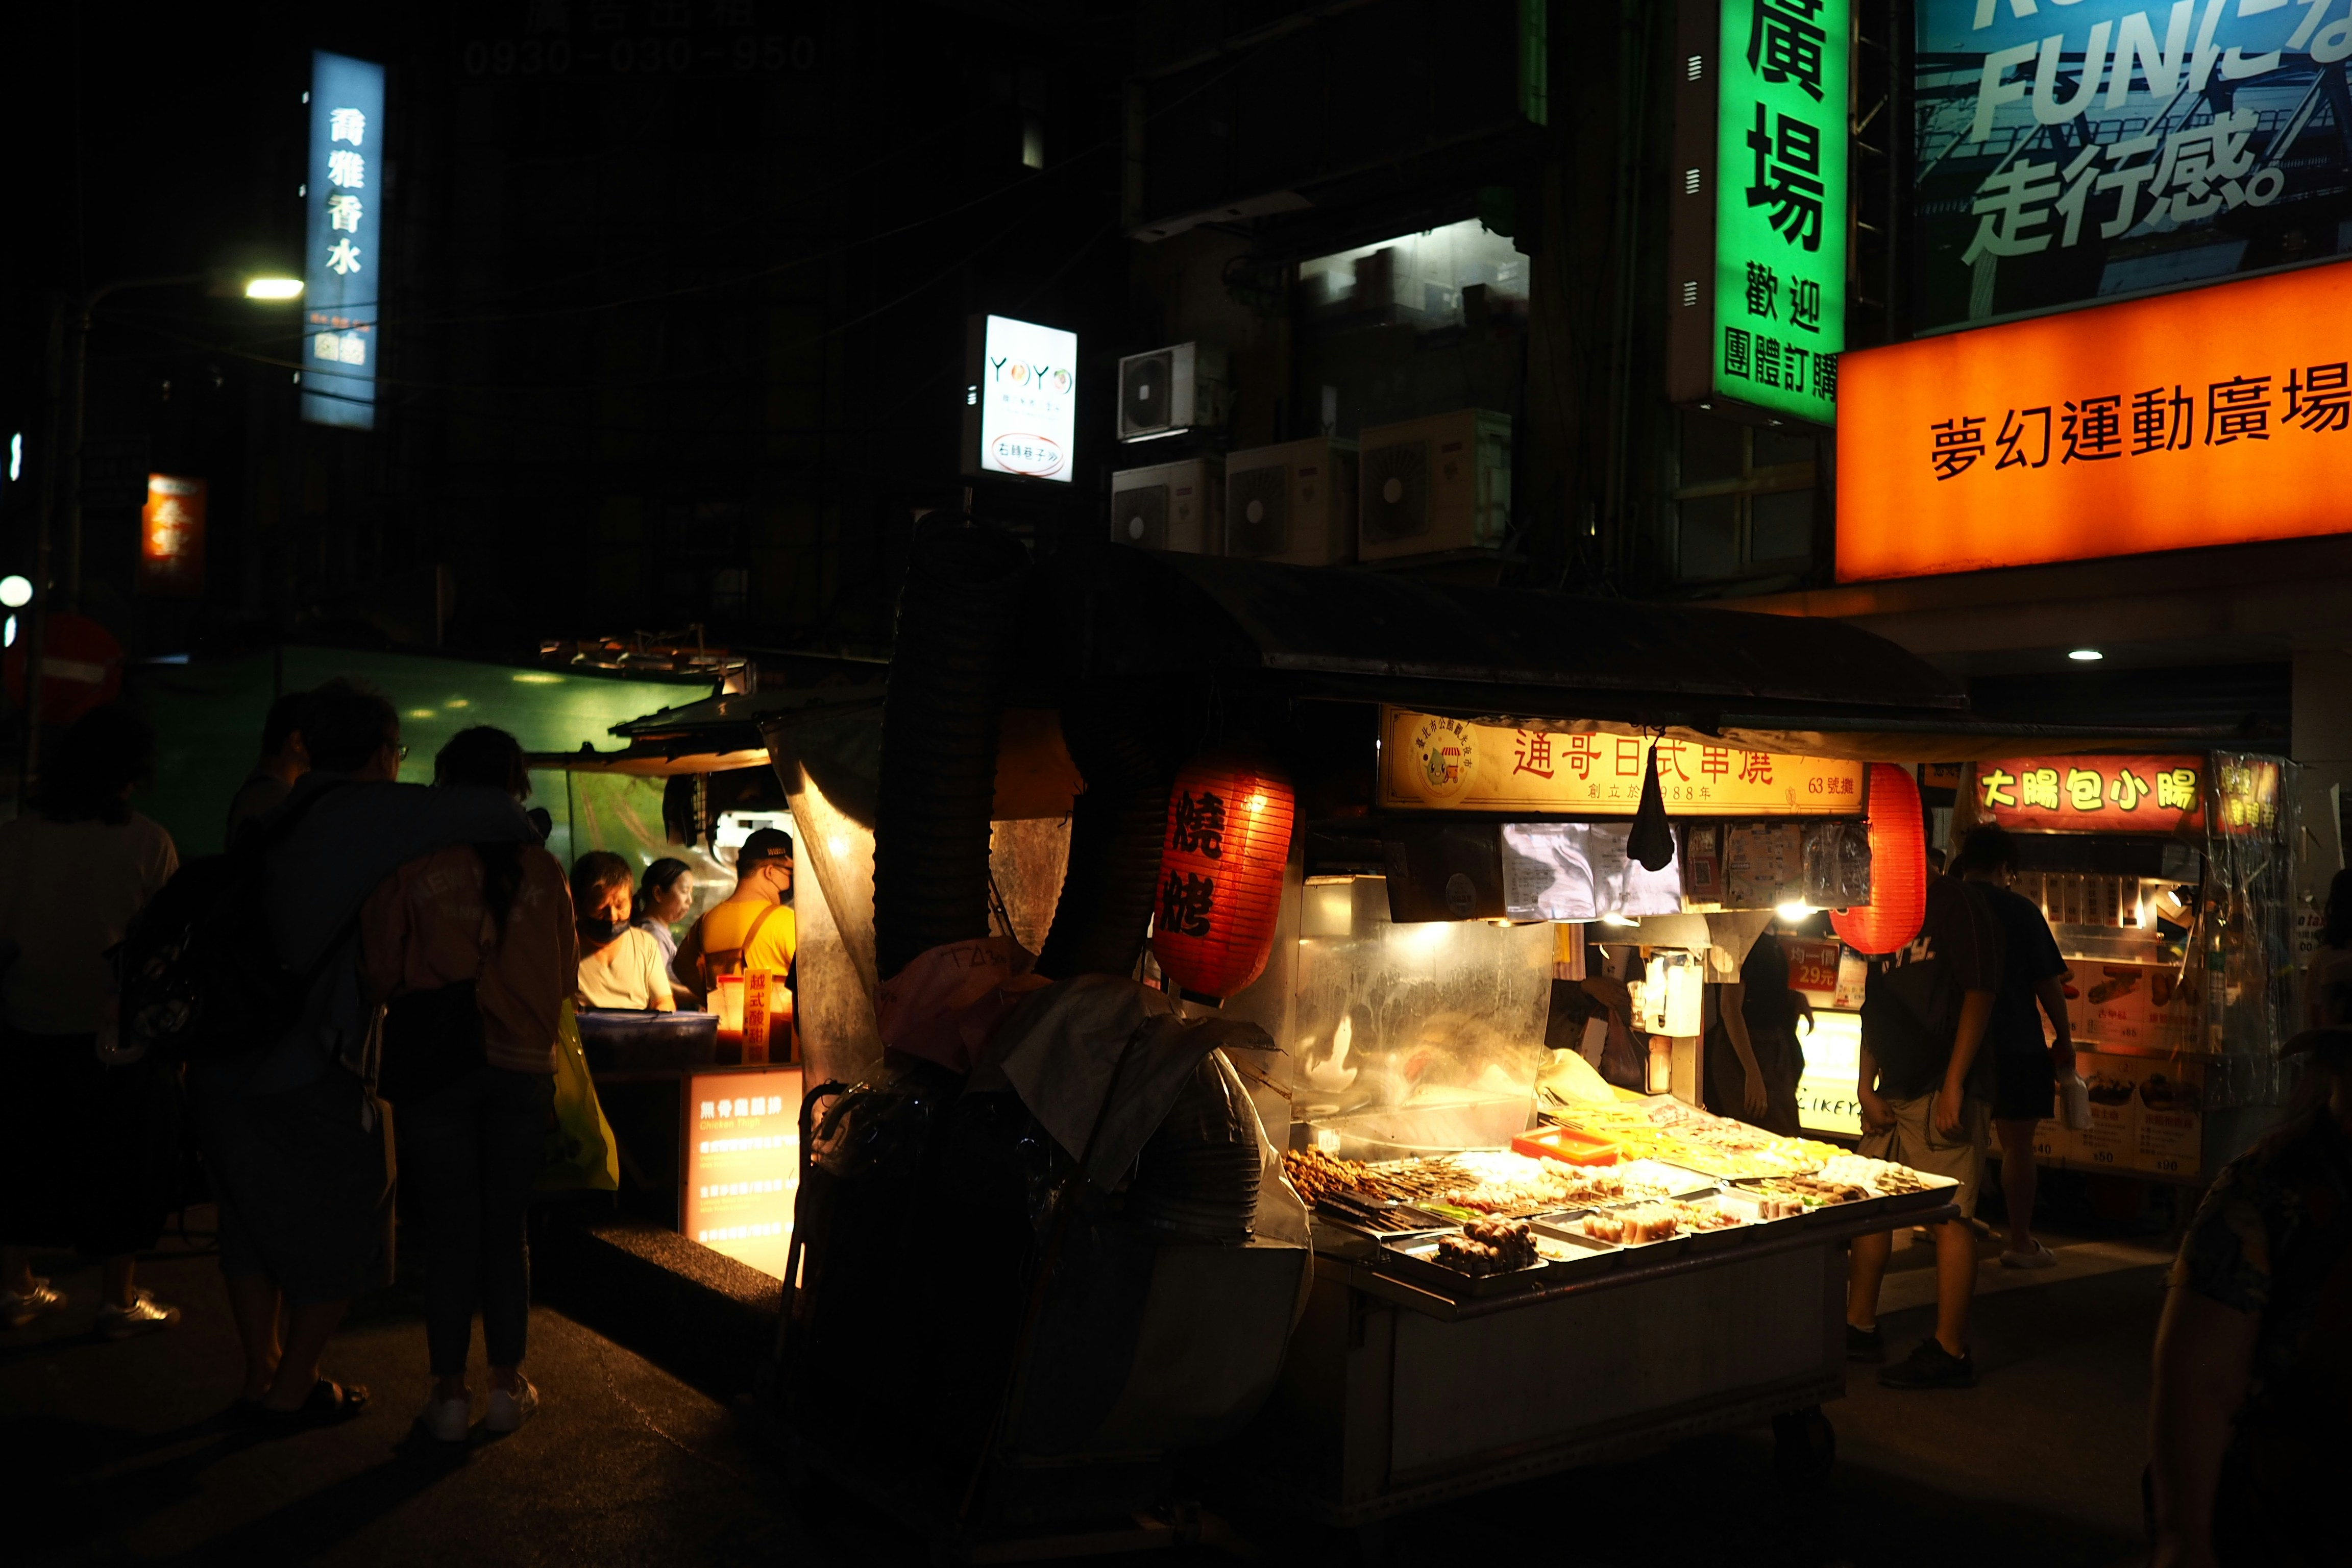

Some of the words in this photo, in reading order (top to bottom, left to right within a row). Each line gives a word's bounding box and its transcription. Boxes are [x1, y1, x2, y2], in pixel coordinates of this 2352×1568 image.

[463, 35, 817, 76] 0930-030-950
[1746, 0, 1826, 253] 廣場
[1746, 260, 1821, 334] 歡迎
[1725, 326, 1837, 403] 團體訂購
[1930, 361, 2351, 481] 夢幻運動廣場
[1513, 729, 1773, 786] 通哥日式串燒
[1588, 783, 1711, 801] 創立於988年
[1982, 767, 2198, 812] 大腸包小腸
[1160, 790, 1226, 937] 燒烤
[1791, 947, 1835, 966] 均一價
[1800, 966, 1833, 986] 29元
[700, 1120, 734, 1131] Chicken
[738, 1117, 761, 1130] Thigh
